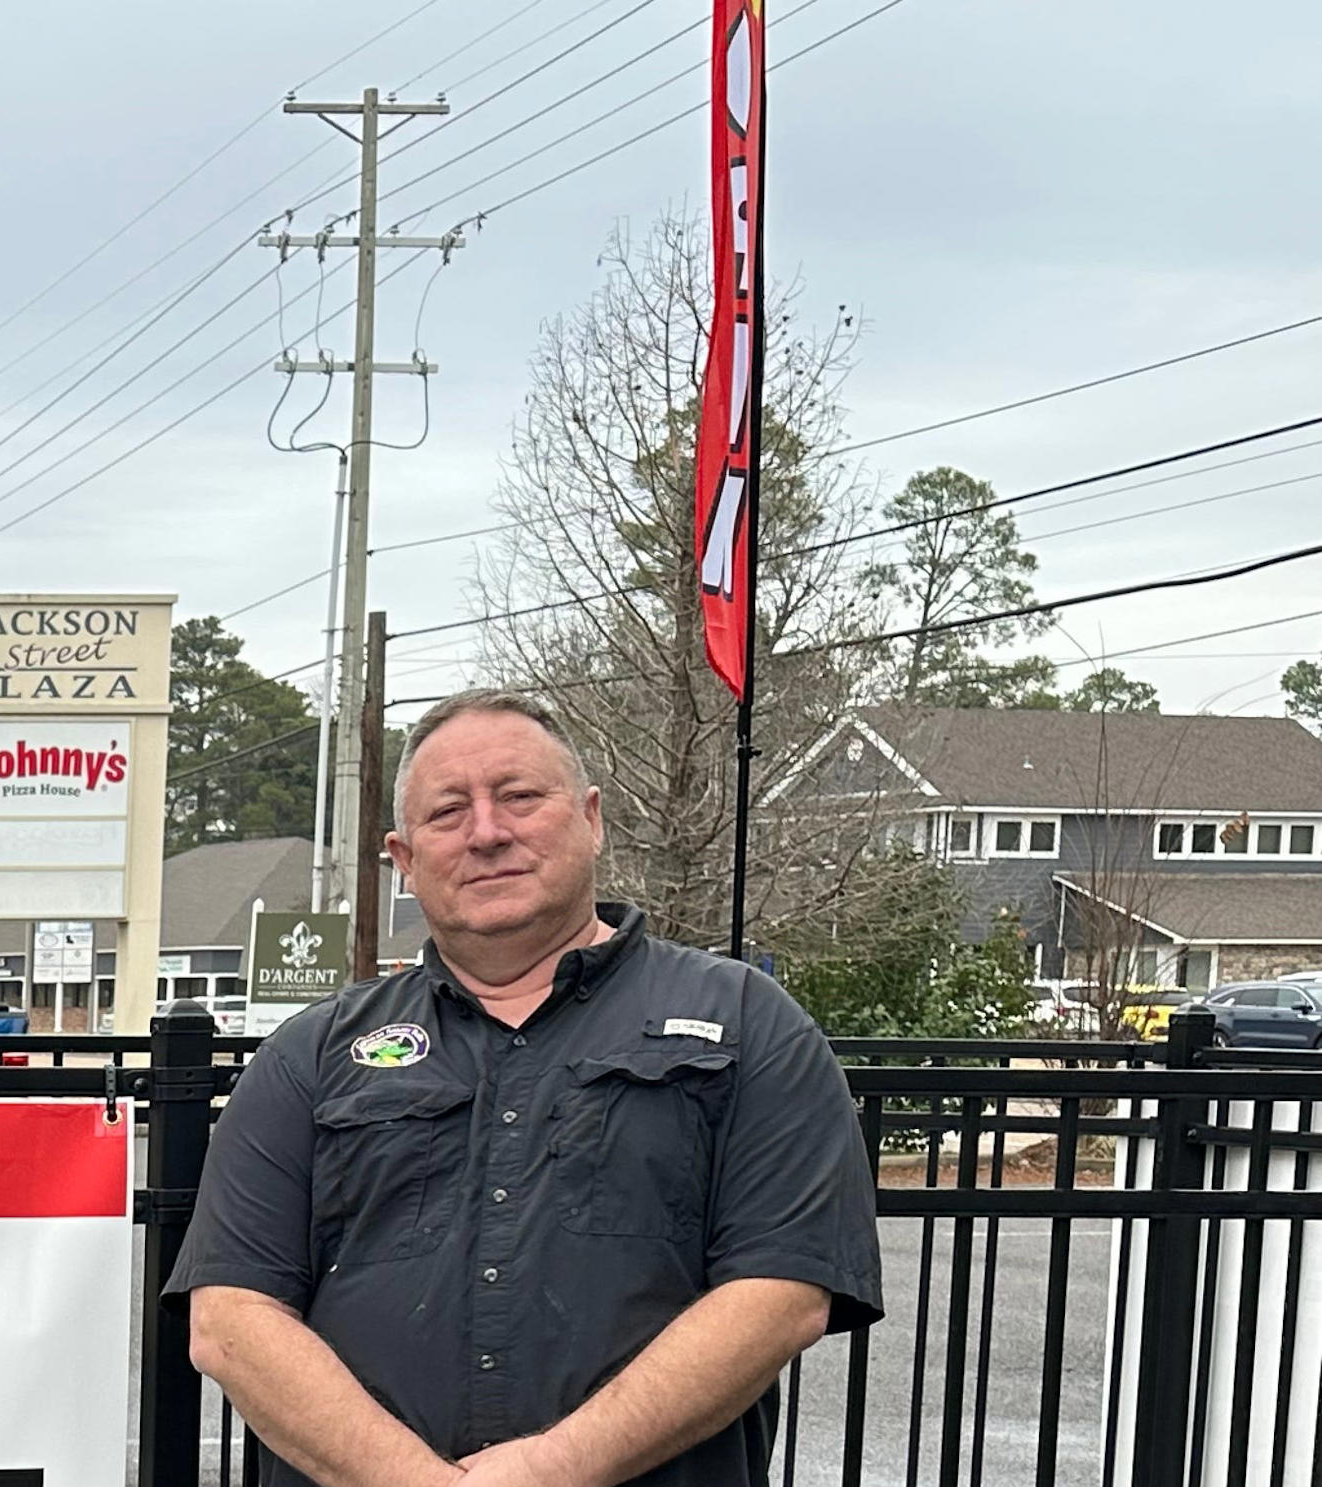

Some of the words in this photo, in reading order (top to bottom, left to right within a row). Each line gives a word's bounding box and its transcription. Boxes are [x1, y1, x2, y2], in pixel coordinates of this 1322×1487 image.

[4, 637, 113, 671] Street
[2, 784, 37, 797] Pizza
[40, 783, 81, 798] House
[259, 968, 338, 984] D'ARGENT
